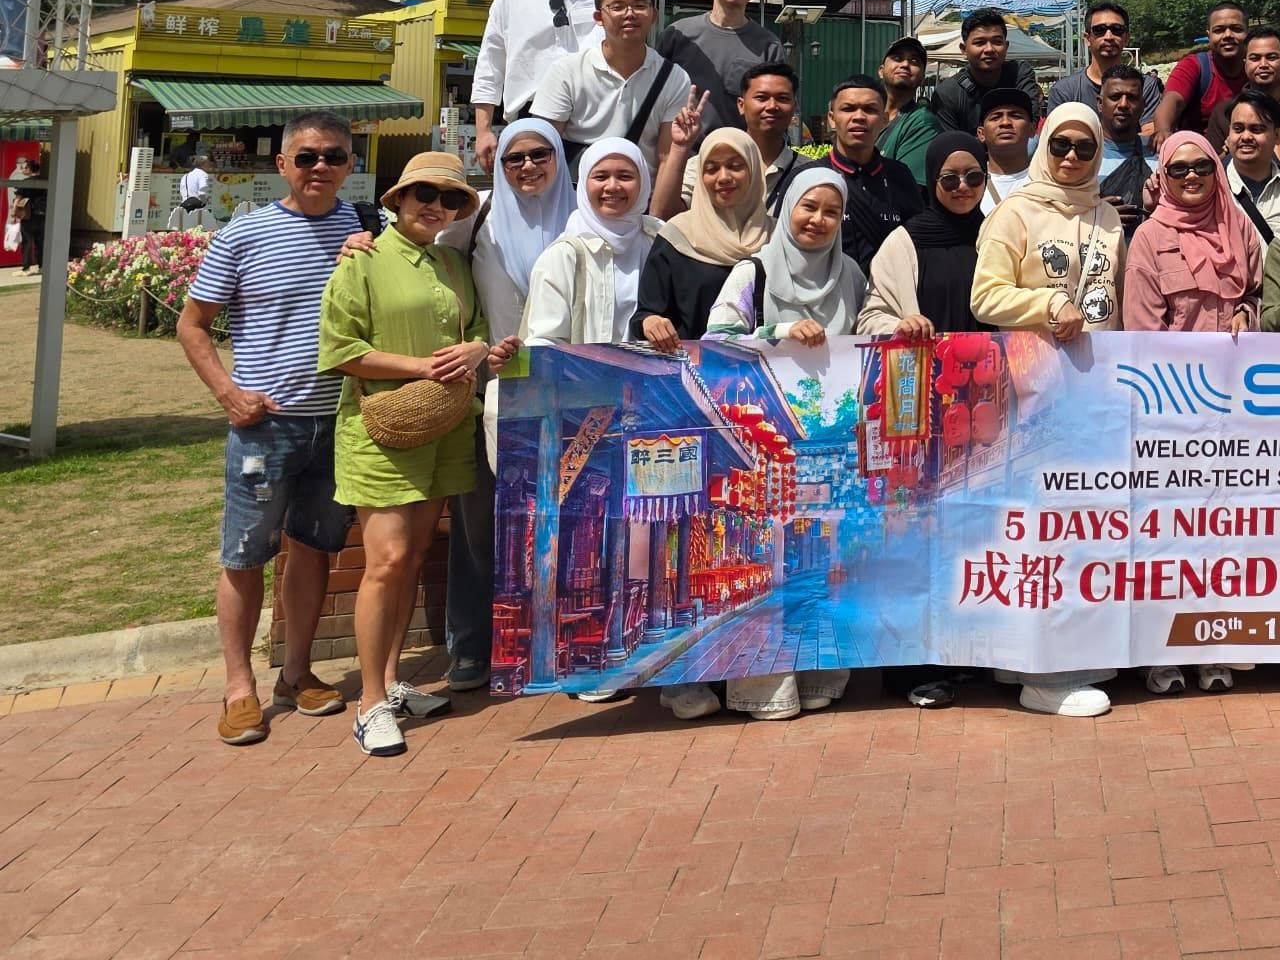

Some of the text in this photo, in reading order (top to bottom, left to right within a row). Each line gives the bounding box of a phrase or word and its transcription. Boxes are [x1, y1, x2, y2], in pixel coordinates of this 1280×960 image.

[1135, 439, 1250, 458] WELCOME
[1042, 471, 1159, 491] WELCOME
[1165, 469, 1270, 489] AIR-TECH
[1005, 511, 1026, 541] 5
[1038, 510, 1130, 542] DAYS
[1139, 509, 1161, 539] 4
[958, 550, 1066, 610] 成都
[1194, 616, 1243, 642] 08th
